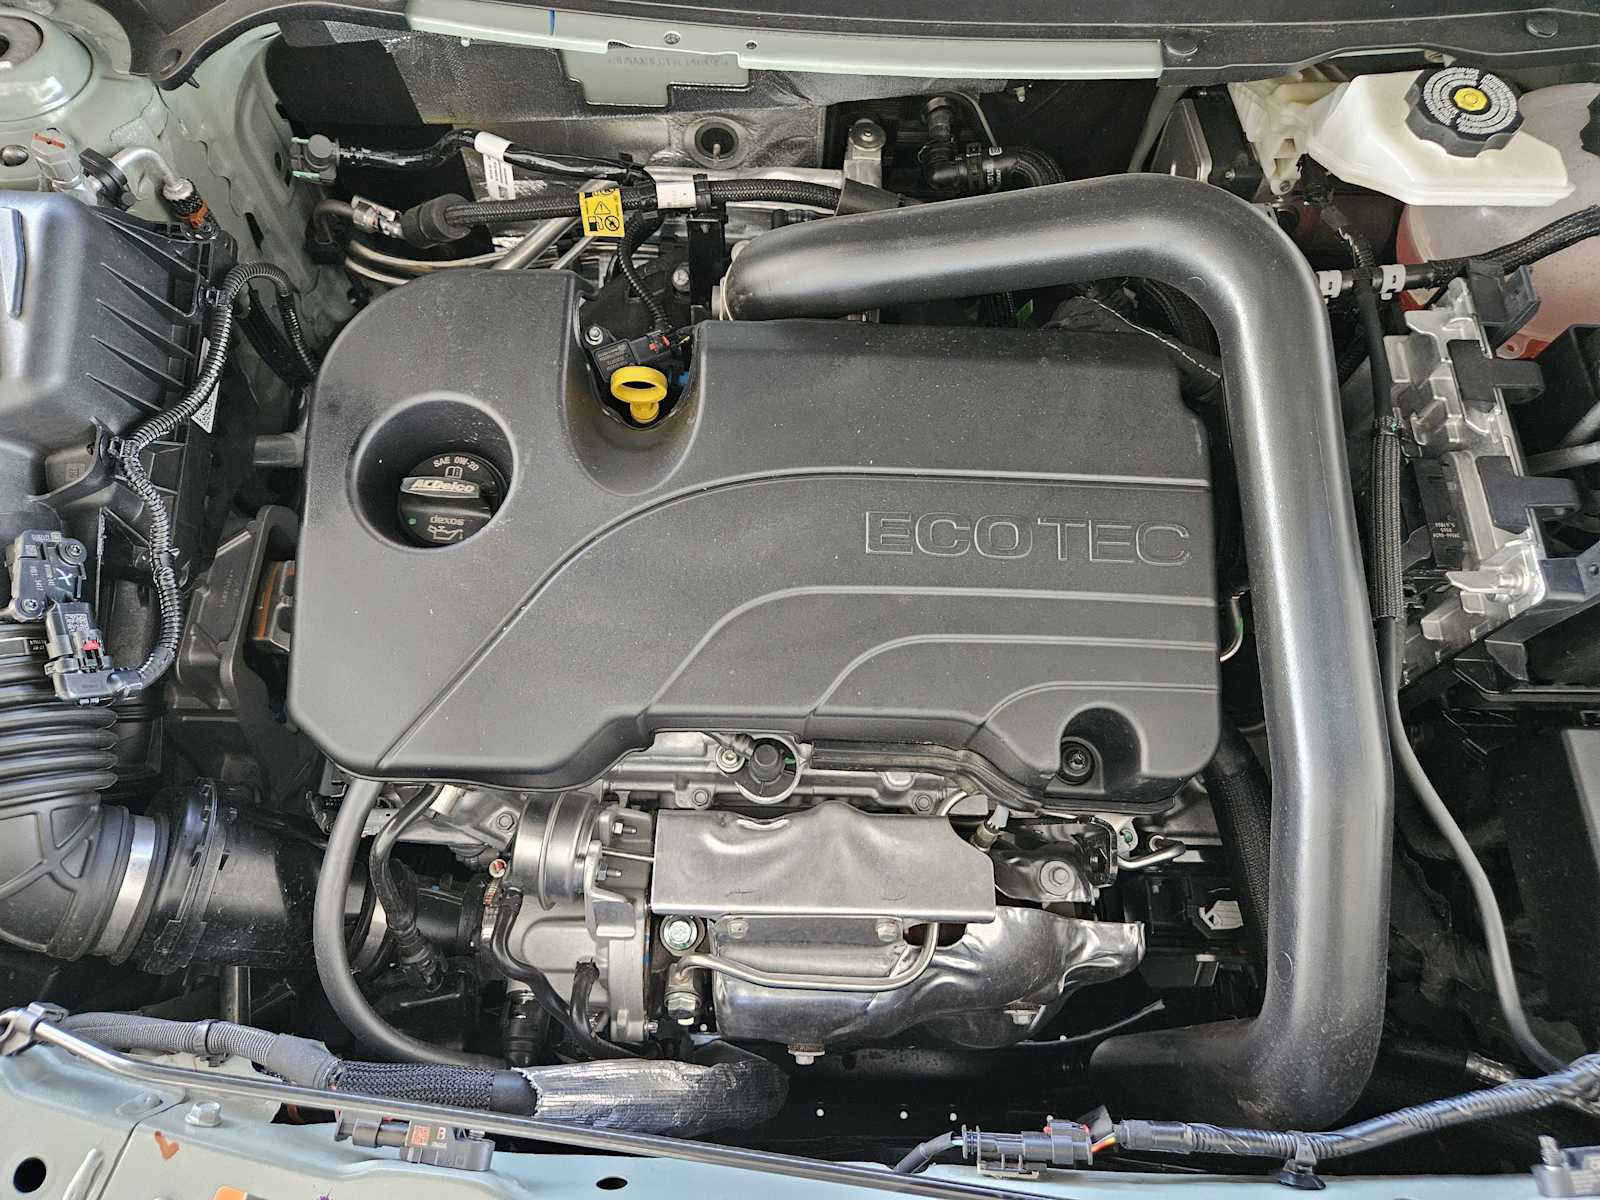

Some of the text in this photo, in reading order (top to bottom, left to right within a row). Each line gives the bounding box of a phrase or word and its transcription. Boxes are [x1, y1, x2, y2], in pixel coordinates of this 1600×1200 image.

[433, 456, 480, 472] SAE 0W-20
[409, 479, 476, 494] ACDelco
[430, 514, 465, 526] dexos
[865, 510, 1191, 567] ECOTEC
